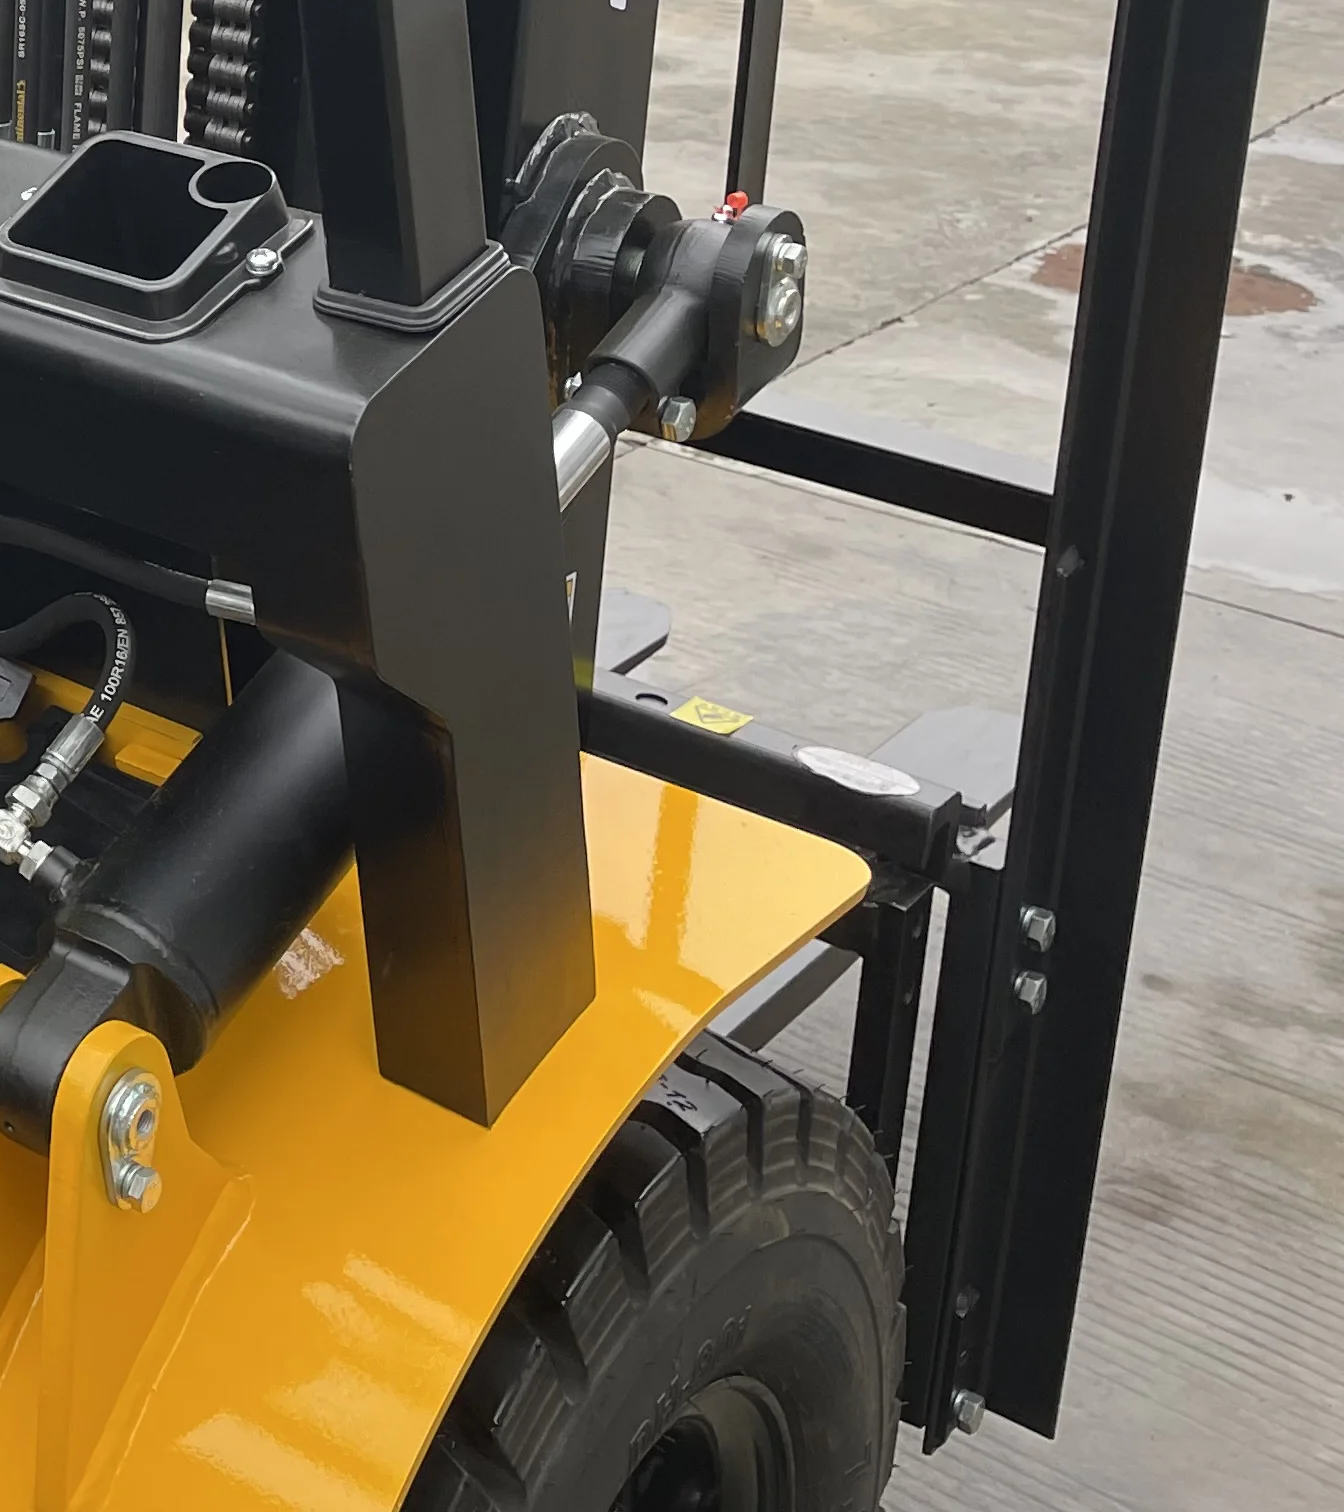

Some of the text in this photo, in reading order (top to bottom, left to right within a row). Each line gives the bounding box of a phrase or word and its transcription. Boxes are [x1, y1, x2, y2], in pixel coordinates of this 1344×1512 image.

[71, 102, 82, 140] FLAME
[86, 704, 105, 724] AE
[100, 628, 130, 702] 100R16/EN
